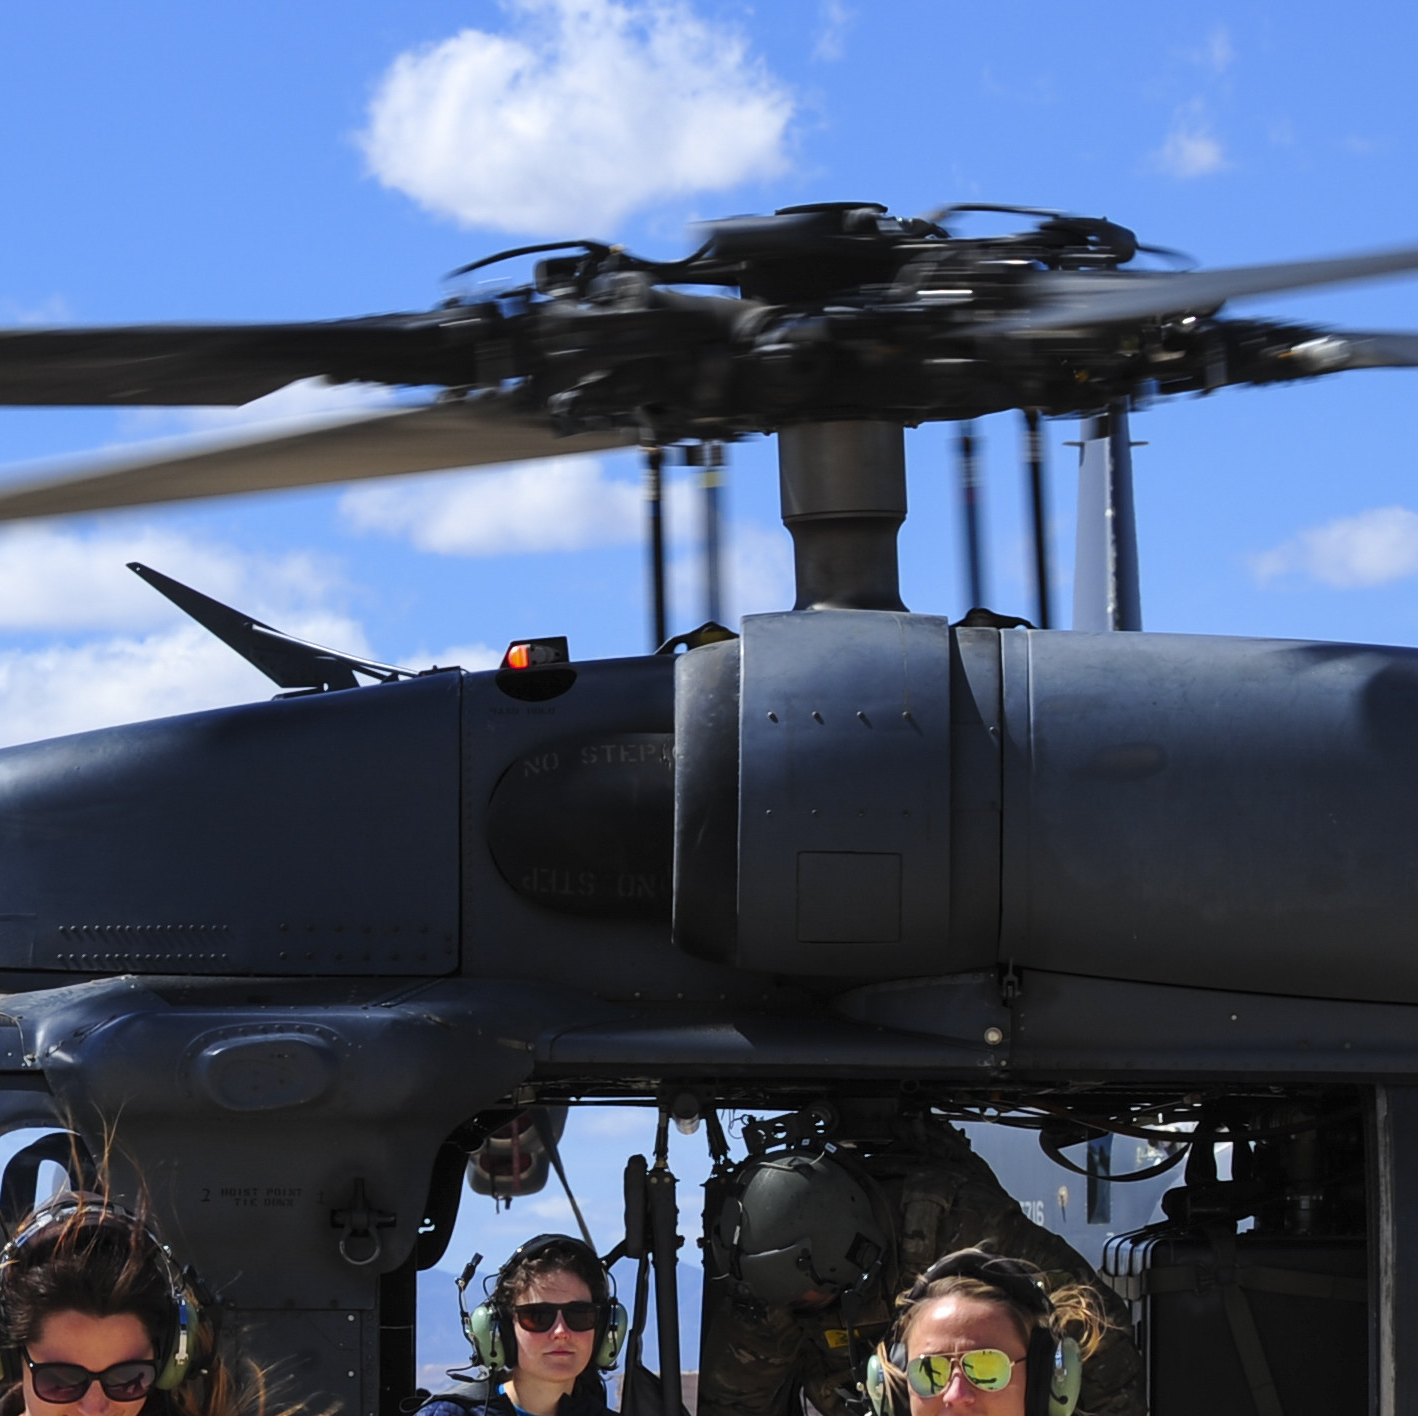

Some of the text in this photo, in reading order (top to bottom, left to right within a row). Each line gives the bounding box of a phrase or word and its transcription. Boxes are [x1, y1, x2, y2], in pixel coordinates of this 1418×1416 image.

[524, 743, 656, 778] NO STEP
[522, 867, 656, 898] NO STEP
